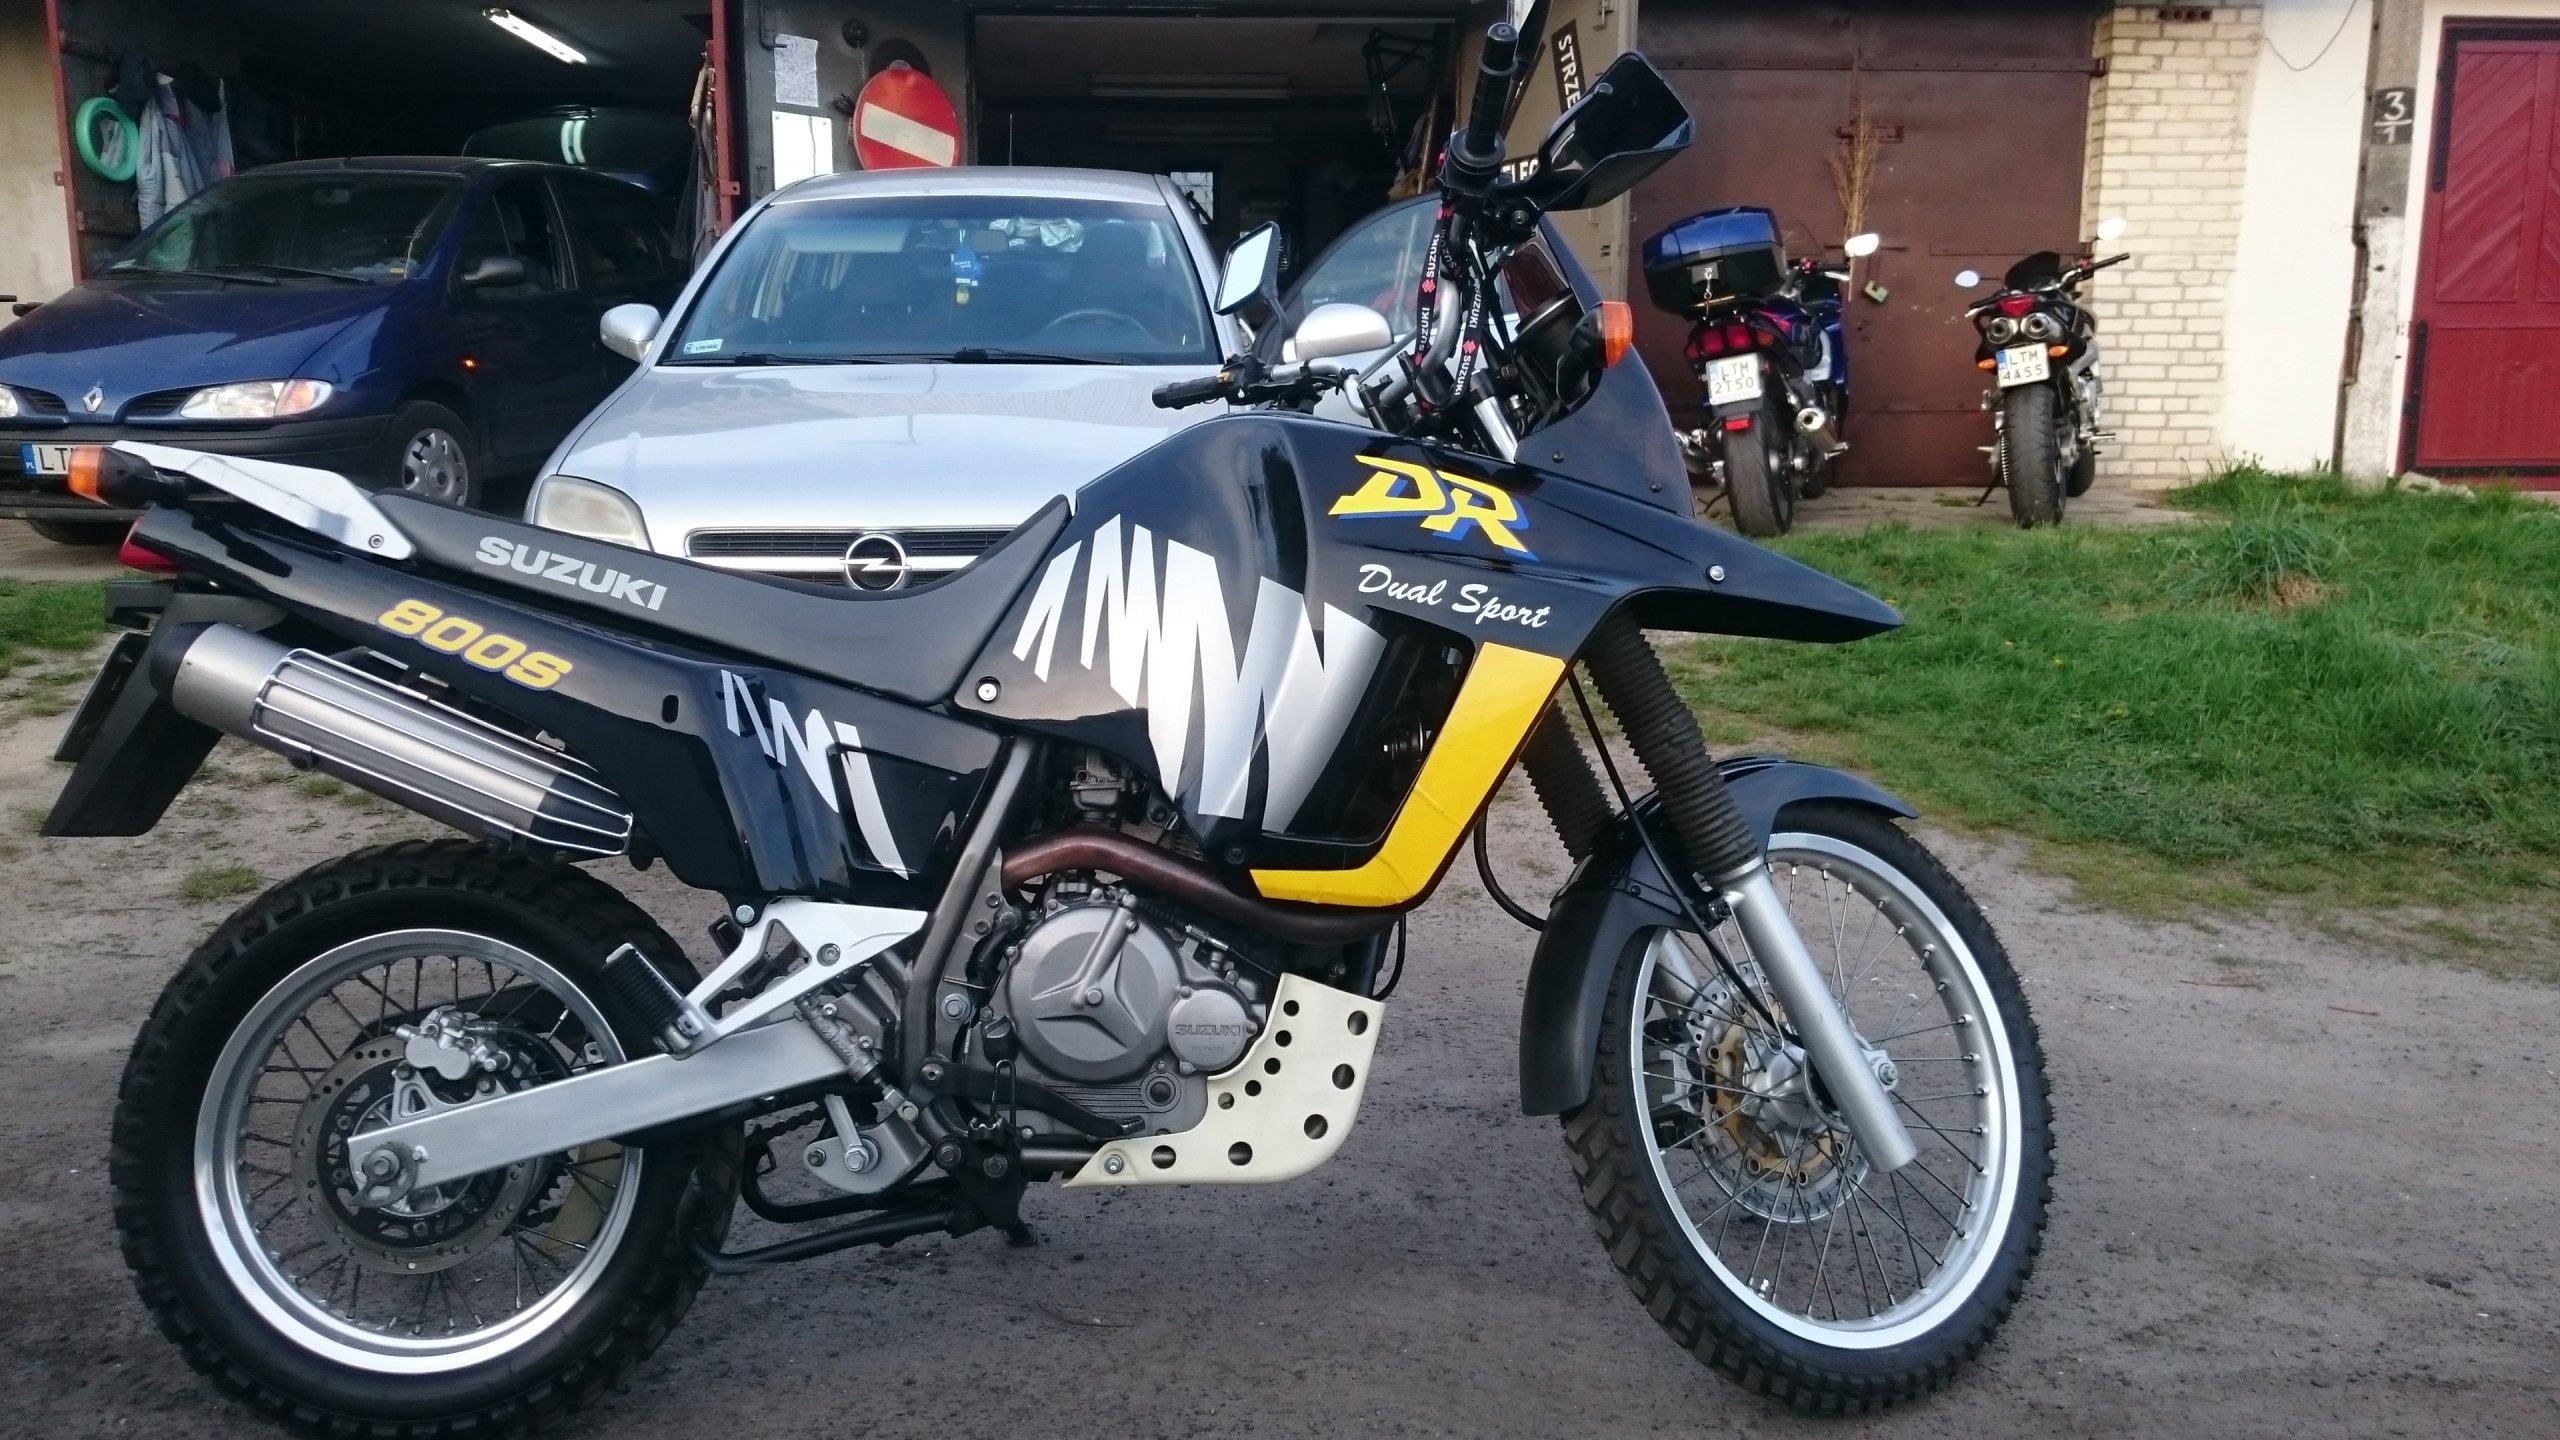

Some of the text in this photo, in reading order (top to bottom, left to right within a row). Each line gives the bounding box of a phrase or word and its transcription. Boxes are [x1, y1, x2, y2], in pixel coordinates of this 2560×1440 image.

[2383, 91, 2406, 120] 3
[1426, 234, 1440, 278] SUZUKI
[1419, 307, 1430, 351] SUZUKI
[1721, 361, 1749, 378] LTM
[2003, 364, 2043, 381] 4A55
[2009, 348, 2038, 366] LTM
[1454, 355, 1471, 396] SUZUKI
[1714, 376, 1754, 394] 2T50
[38, 446, 74, 471] LT
[1328, 454, 1537, 560] DR
[475, 536, 668, 611] SUZUKI
[1357, 563, 1551, 628] Dual Sport
[377, 598, 573, 690] 800S
[1175, 1024, 1241, 1037] SUZUKI
